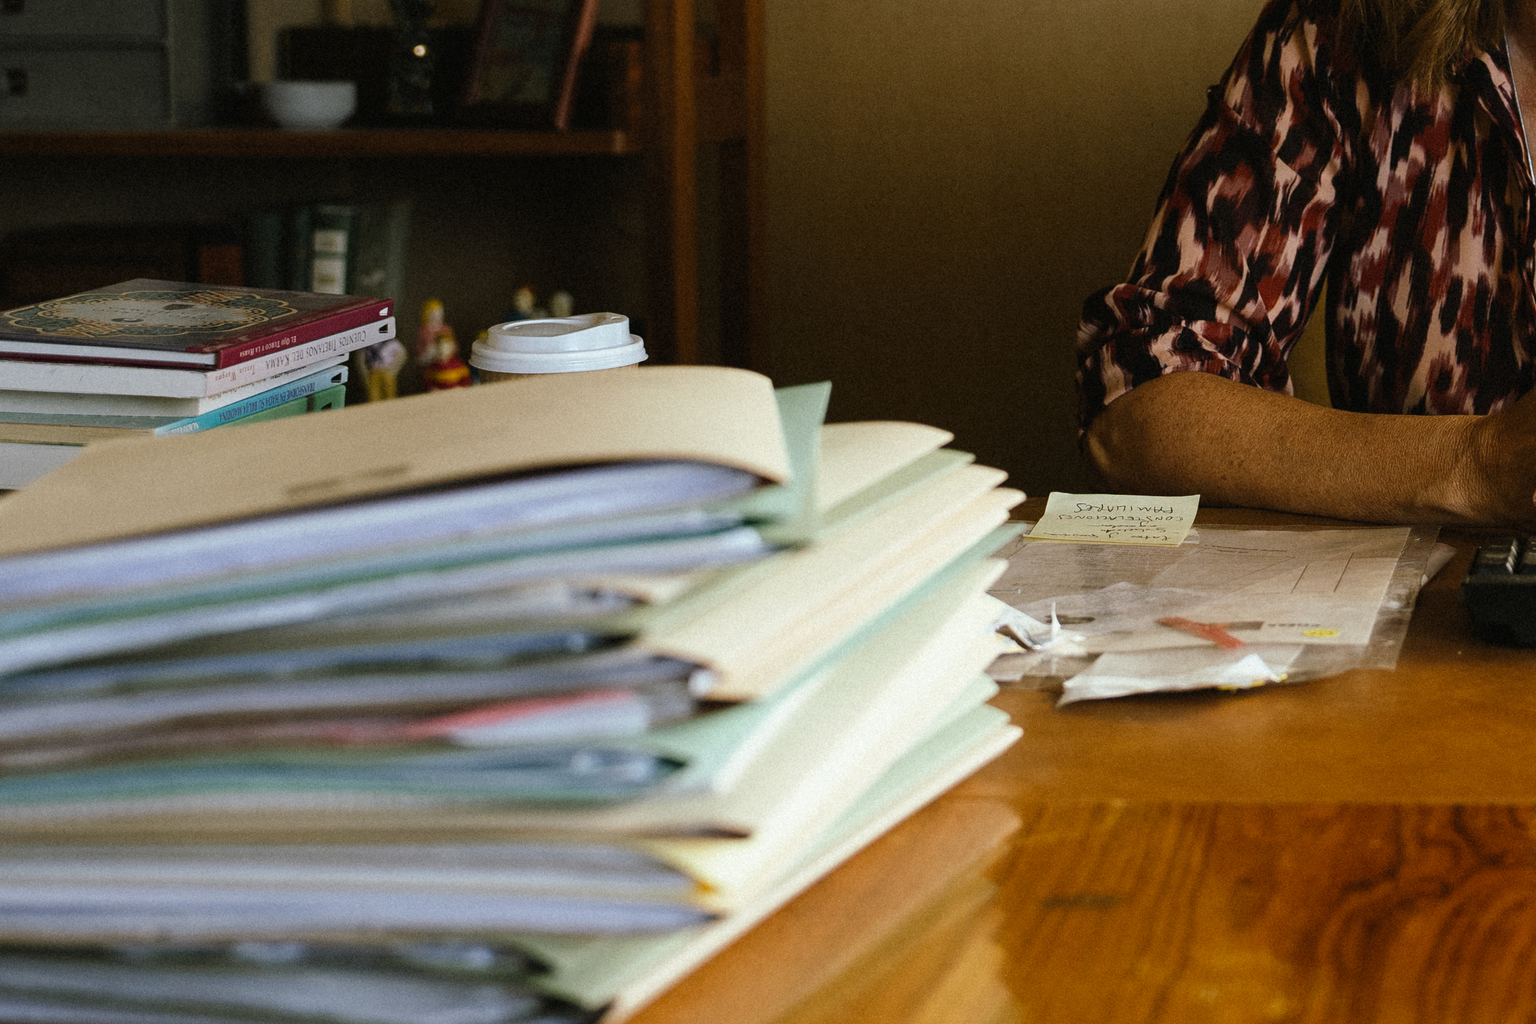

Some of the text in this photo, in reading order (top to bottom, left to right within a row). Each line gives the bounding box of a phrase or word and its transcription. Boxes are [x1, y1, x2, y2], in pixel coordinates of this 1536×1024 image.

[265, 330, 367, 370] CUENTOS TIBETANOS DEL KARMA
[1073, 502, 1174, 514] FAMILIARES
[1058, 514, 1184, 522] CONSTELACIONES
